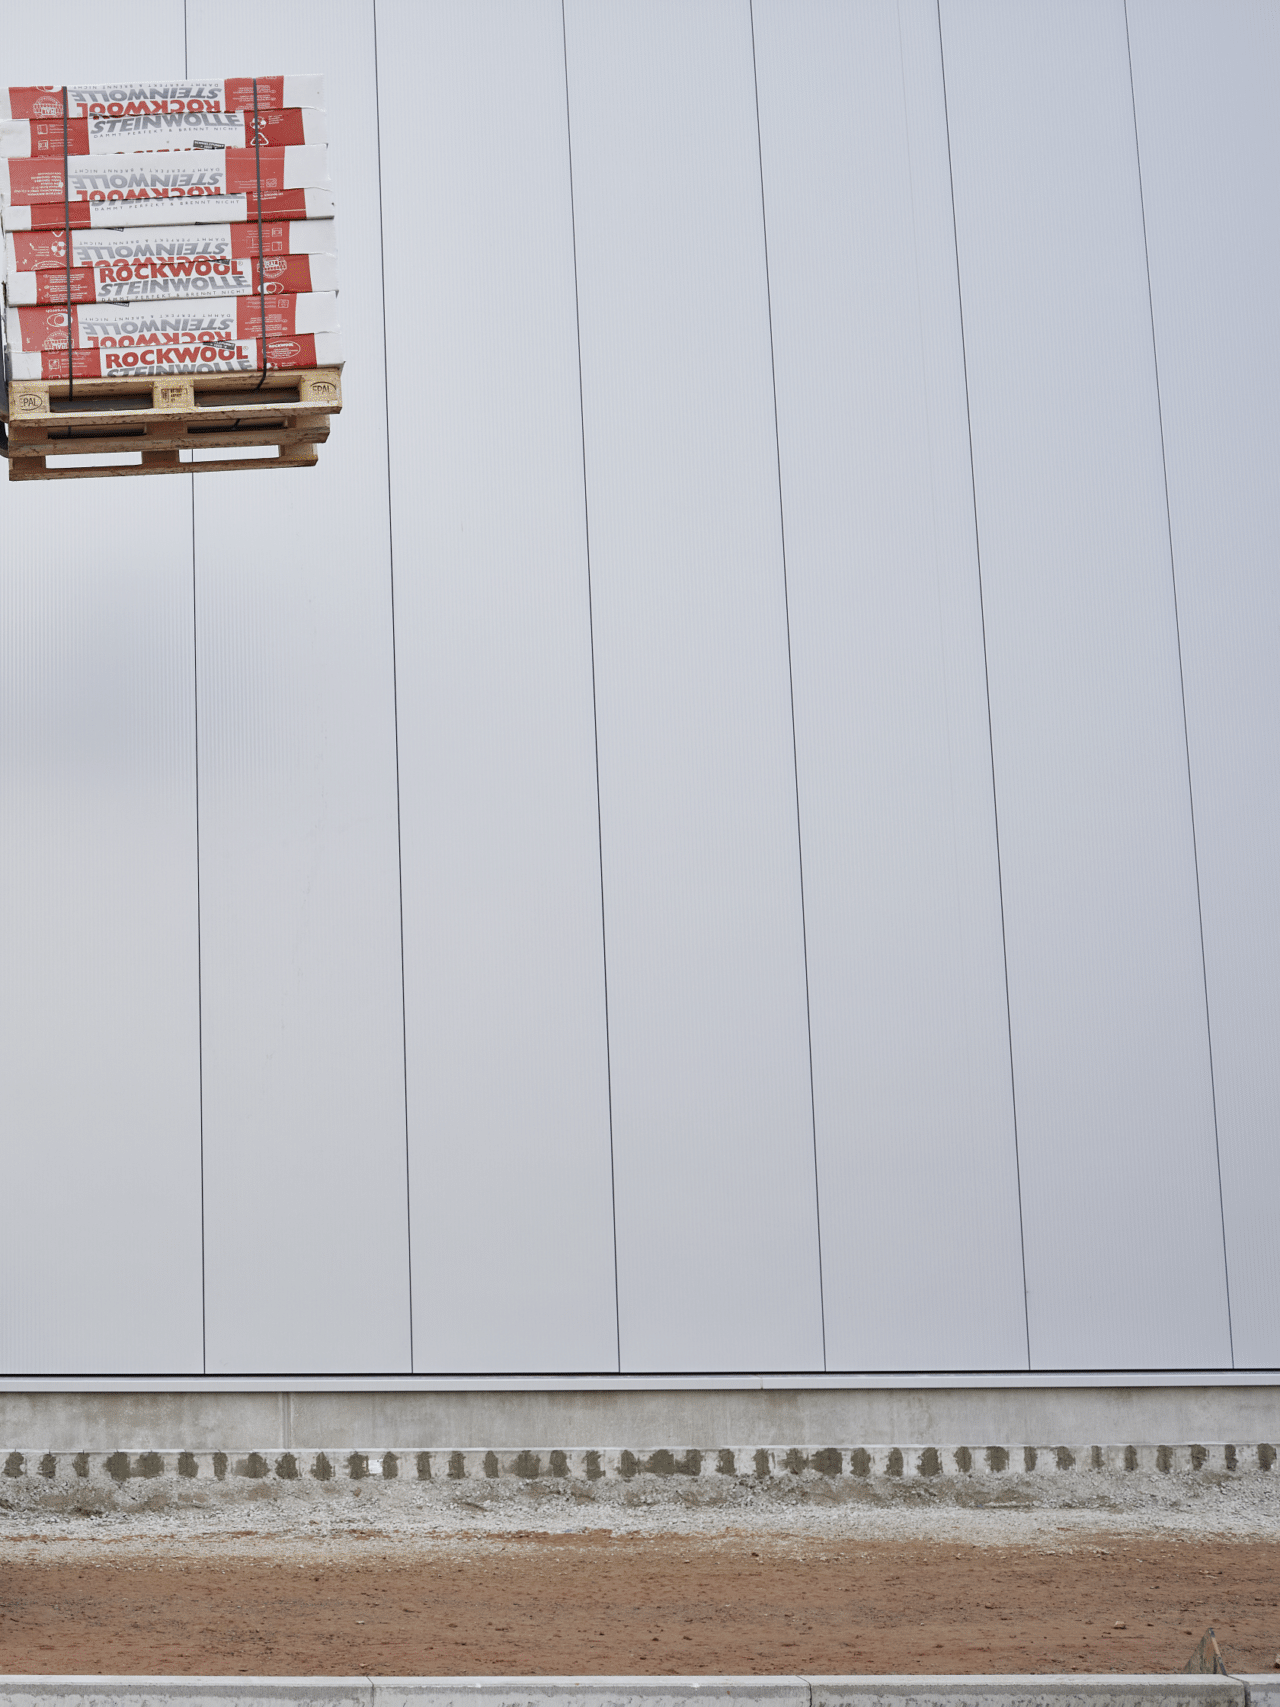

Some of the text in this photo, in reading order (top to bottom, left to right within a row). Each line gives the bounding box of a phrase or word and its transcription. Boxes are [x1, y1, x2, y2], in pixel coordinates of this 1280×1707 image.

[68, 88, 222, 102] STEINWOLLE
[76, 99, 221, 118] ROCKWOOL
[90, 114, 244, 134] STEINWOLLE
[69, 173, 223, 189] STEINWOLLE
[74, 242, 229, 260] STEINWOLLE
[100, 260, 243, 283] ROCKWOOL
[98, 276, 251, 296] STEINWOLLE
[79, 318, 234, 335] STEINWOLLE
[106, 346, 248, 369] ROCKWOOL
[107, 360, 252, 377] STEINWOLLE
[22, 398, 38, 406] PAL
